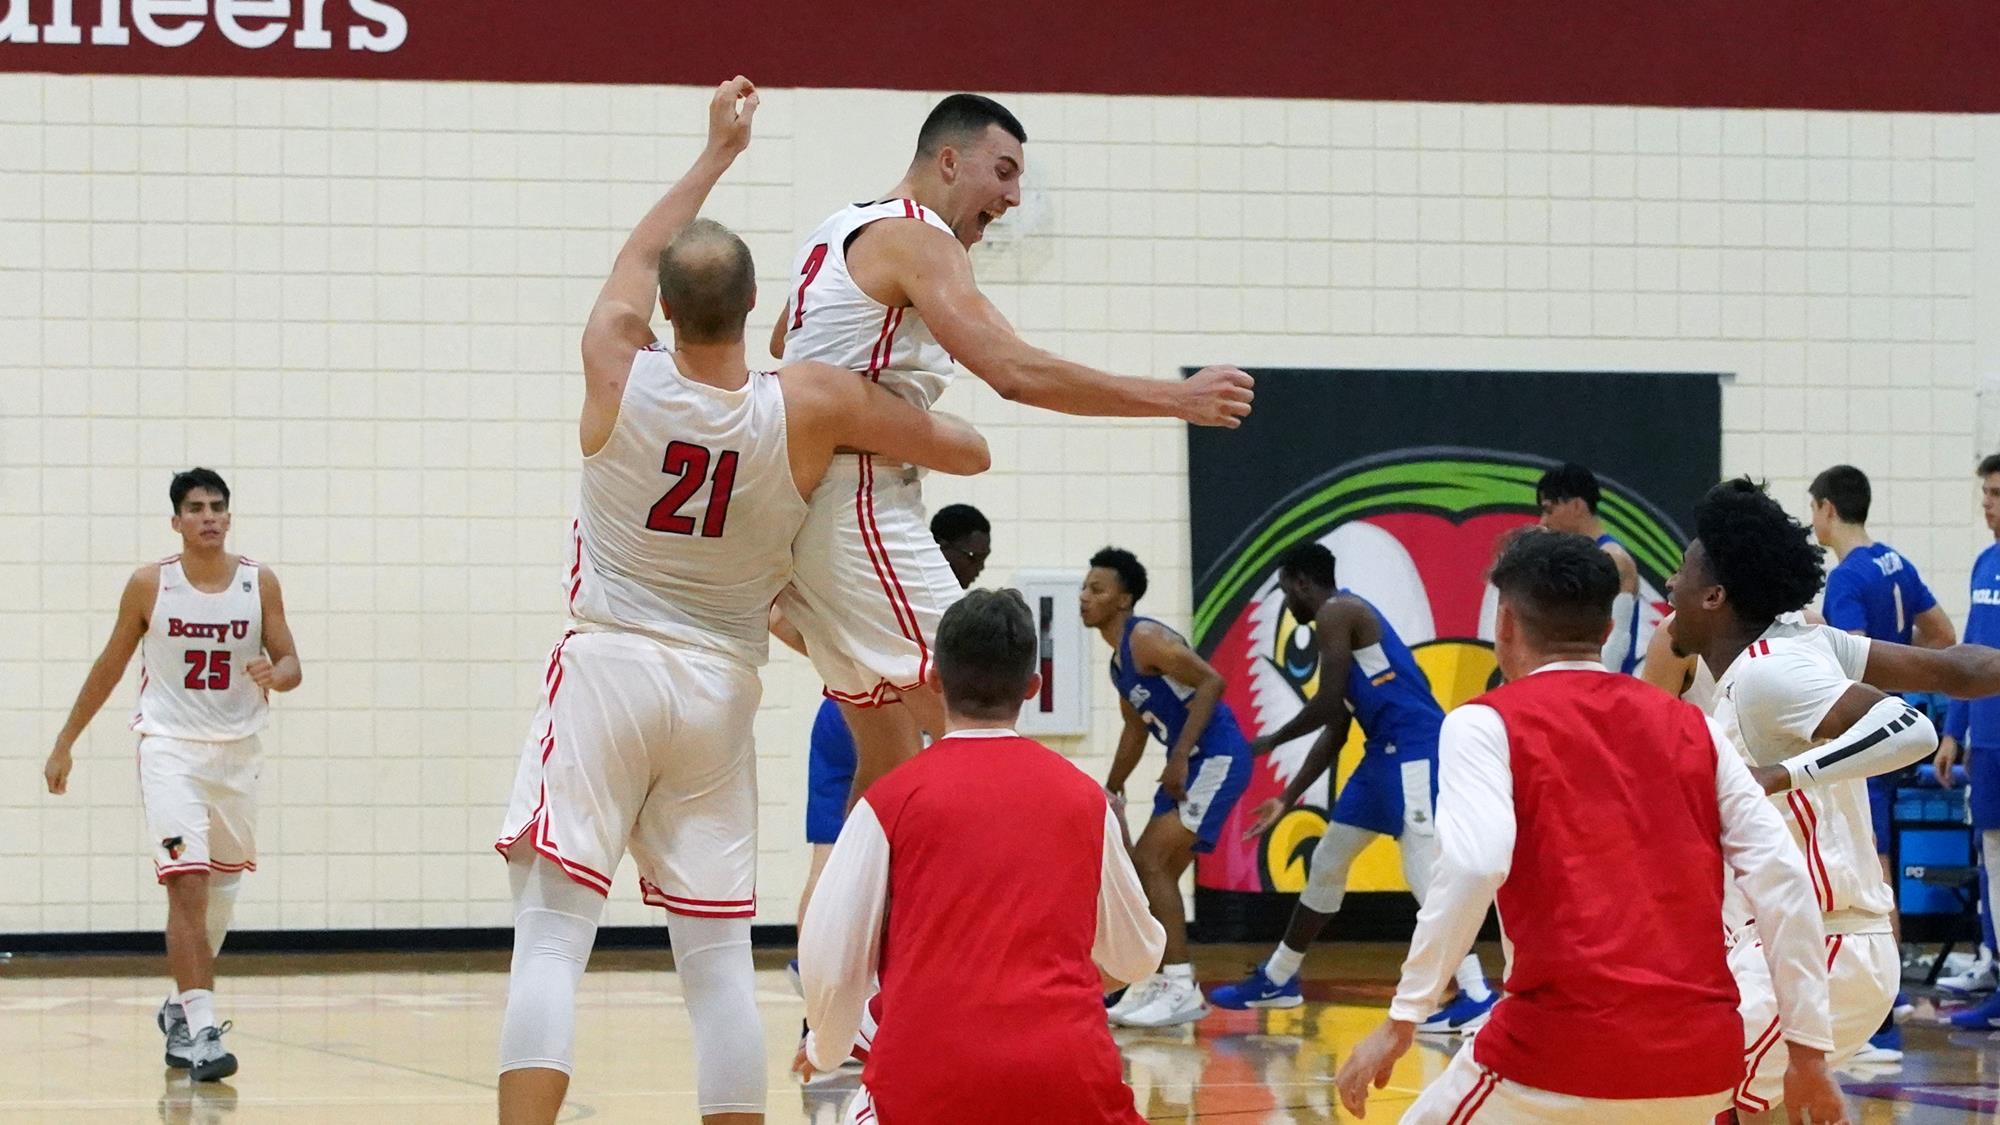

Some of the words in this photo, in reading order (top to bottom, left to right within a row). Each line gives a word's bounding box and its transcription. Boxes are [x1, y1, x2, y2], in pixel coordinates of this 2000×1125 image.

[645, 440, 740, 537] 21
[168, 618, 230, 643] Barry
[230, 620, 249, 639] U
[184, 650, 231, 690] 25
